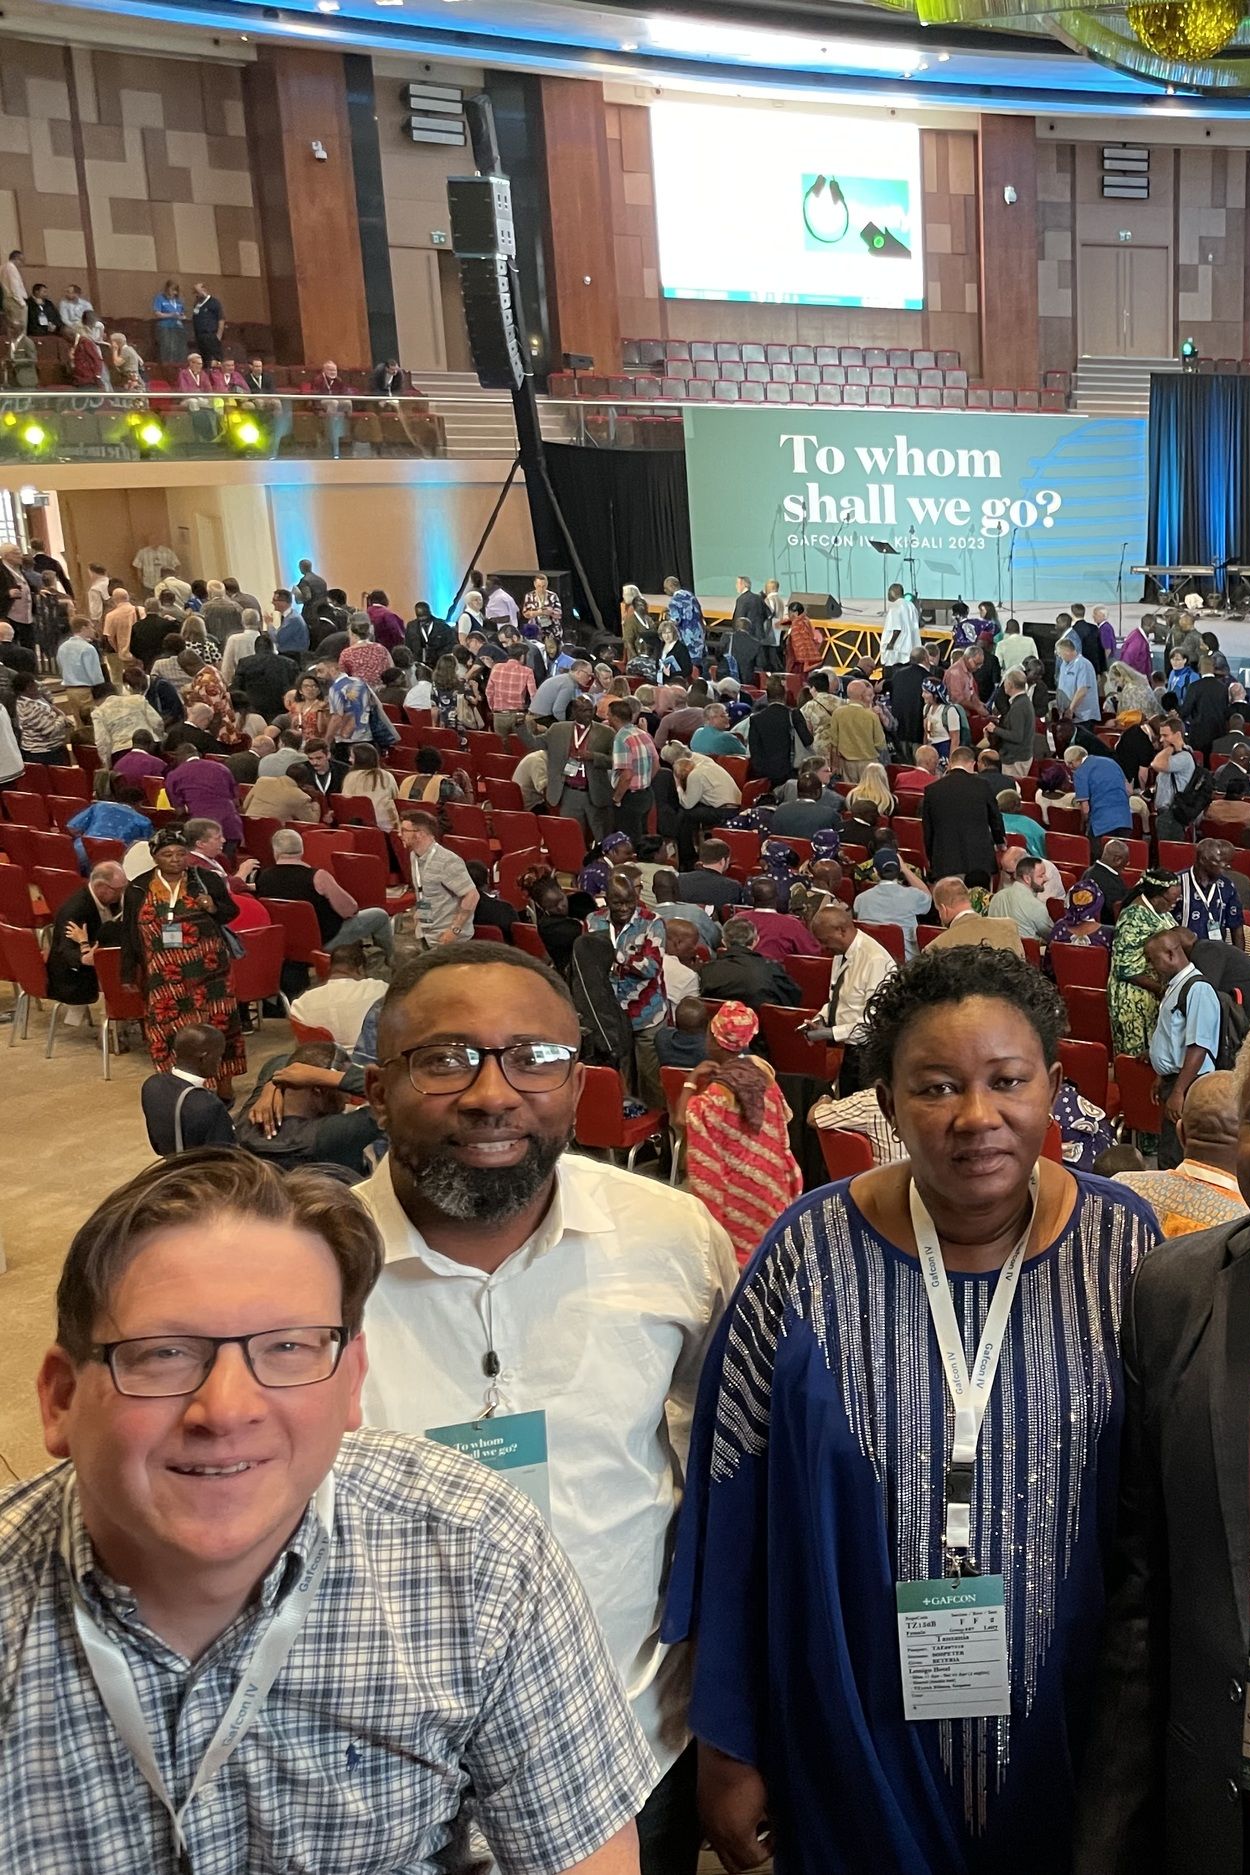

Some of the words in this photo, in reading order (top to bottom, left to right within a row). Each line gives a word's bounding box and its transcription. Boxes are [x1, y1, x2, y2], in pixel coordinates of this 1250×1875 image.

[779, 433, 846, 476] To
[854, 435, 1003, 479] whom
[782, 482, 898, 526] shall
[906, 496, 971, 527] we
[980, 489, 1063, 538] go?
[787, 534, 854, 548] GAFCON
[894, 536, 943, 549] KIGALI
[948, 536, 986, 550] 2023
[924, 1246, 933, 1256] IV
[928, 1256, 940, 1288] Gafcon
[946, 1351, 956, 1361] IV
[978, 1343, 993, 1377] Gafcon
[951, 1363, 964, 1395] Gafcon
[976, 1378, 986, 1390] IV
[470, 1437, 504, 1449] whom
[482, 1449, 497, 1457] we
[498, 1443, 518, 1456] go?
[298, 1547, 326, 1593] Gafcon
[931, 1593, 977, 1606] GAFCON
[222, 1701, 252, 1747] Gafcon
[244, 1682, 259, 1698] IV
